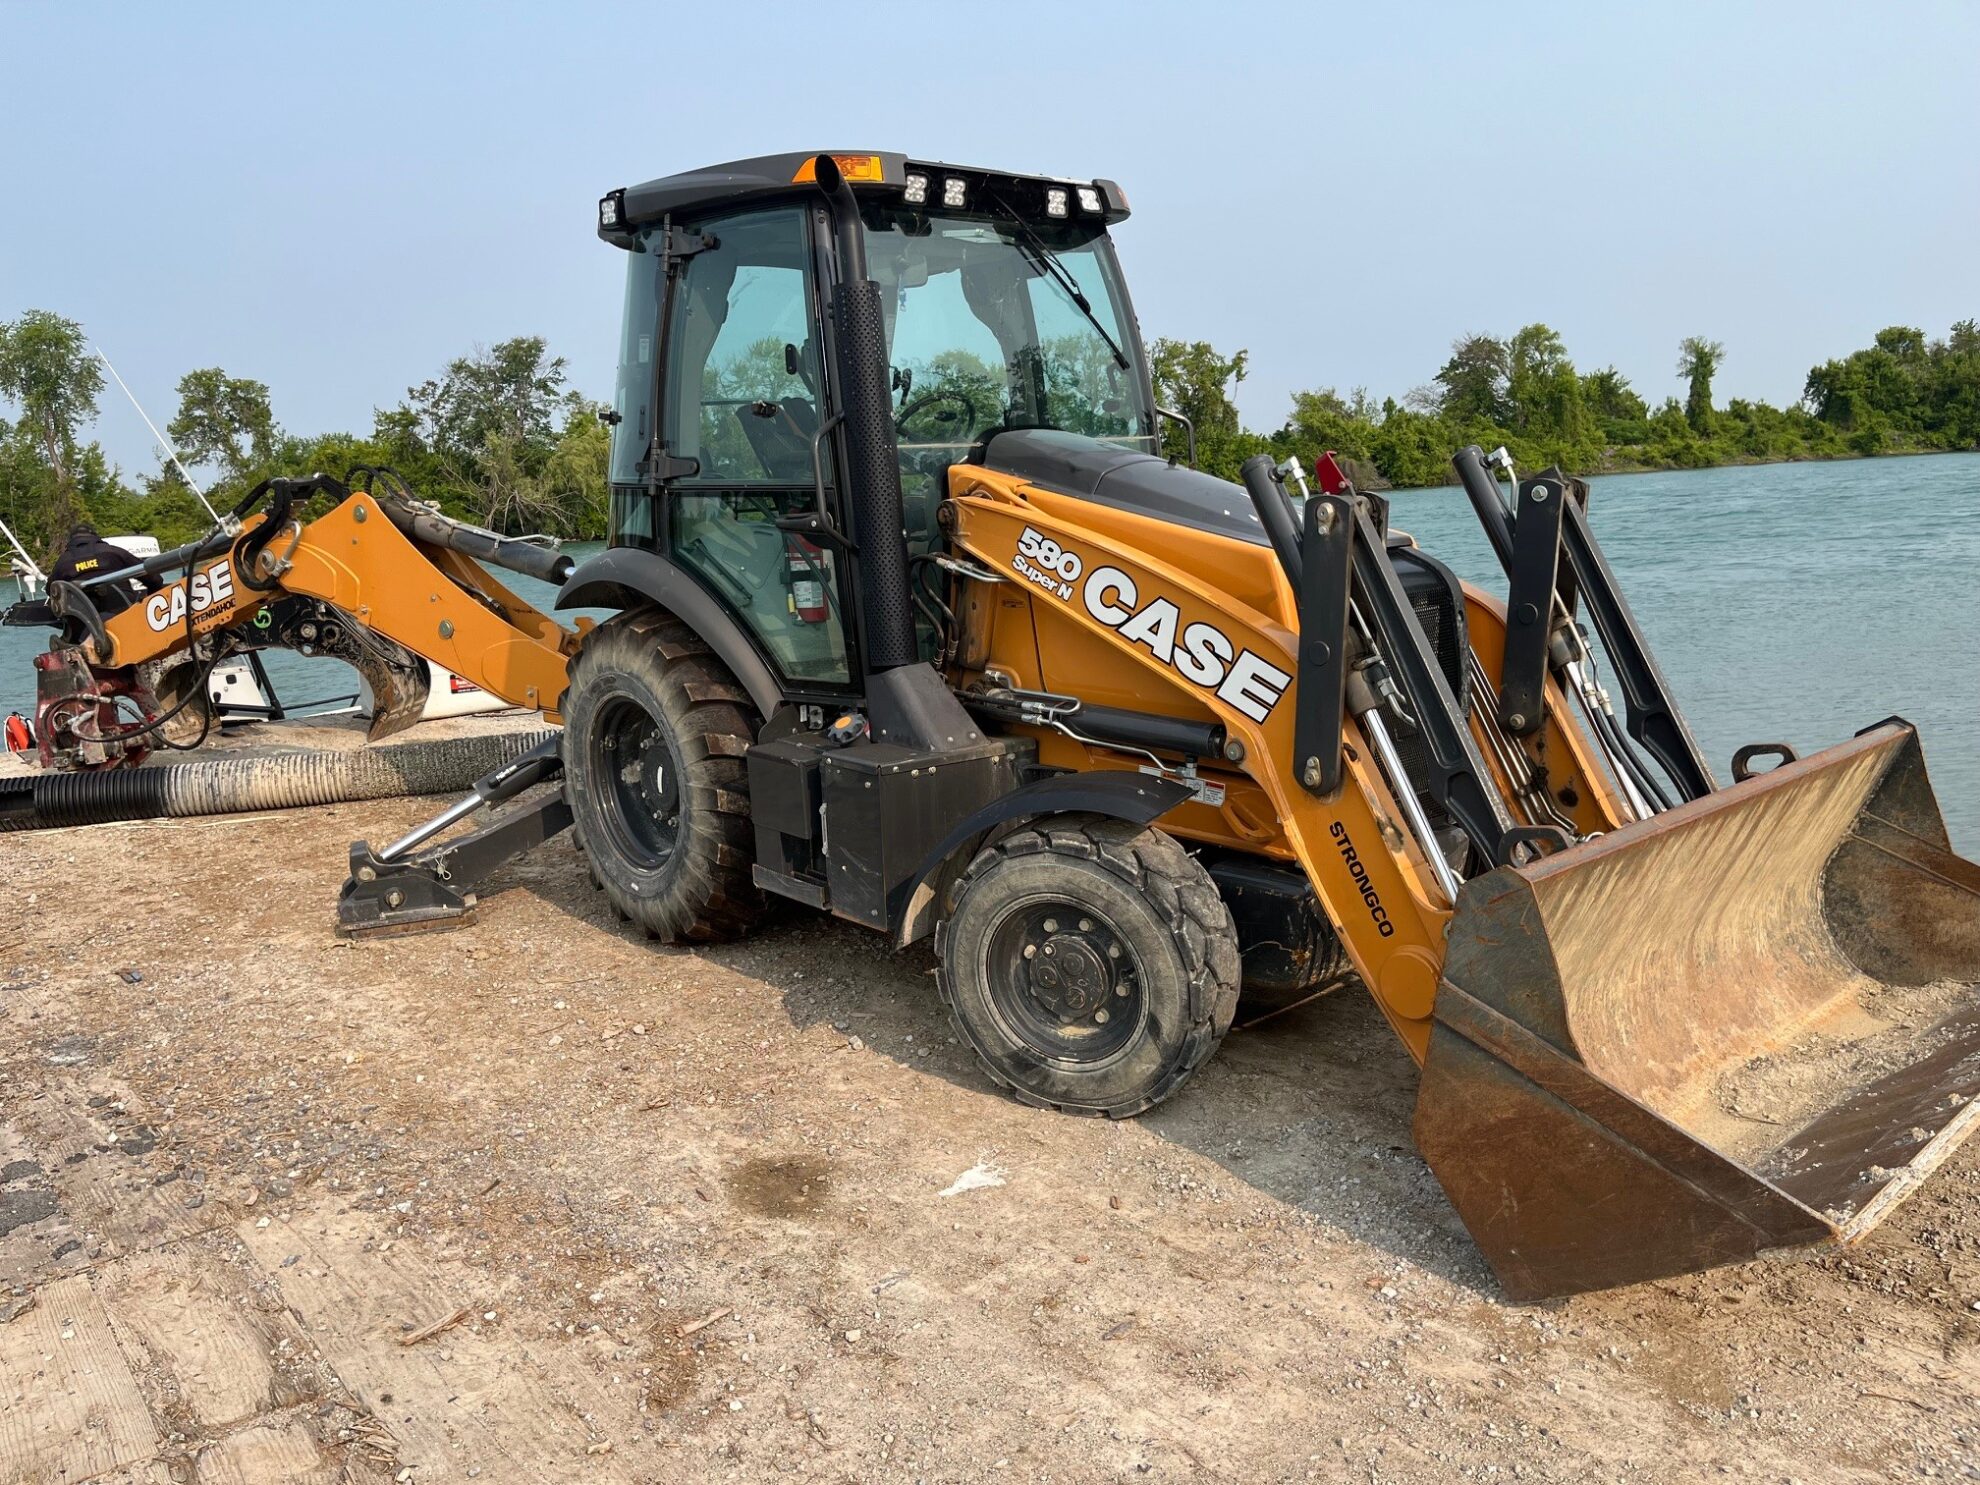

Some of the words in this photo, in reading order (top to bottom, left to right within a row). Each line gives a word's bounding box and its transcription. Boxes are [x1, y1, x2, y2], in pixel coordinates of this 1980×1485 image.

[75, 559, 99, 573] POLICE
[1012, 554, 1058, 591] Super
[1057, 582, 1074, 602] N
[1017, 525, 1082, 582] 580
[146, 559, 234, 632] CASE
[190, 598, 236, 627] XTENDAHOE
[1083, 566, 1293, 725] CASE
[1329, 821, 1394, 938] STRONGCO
